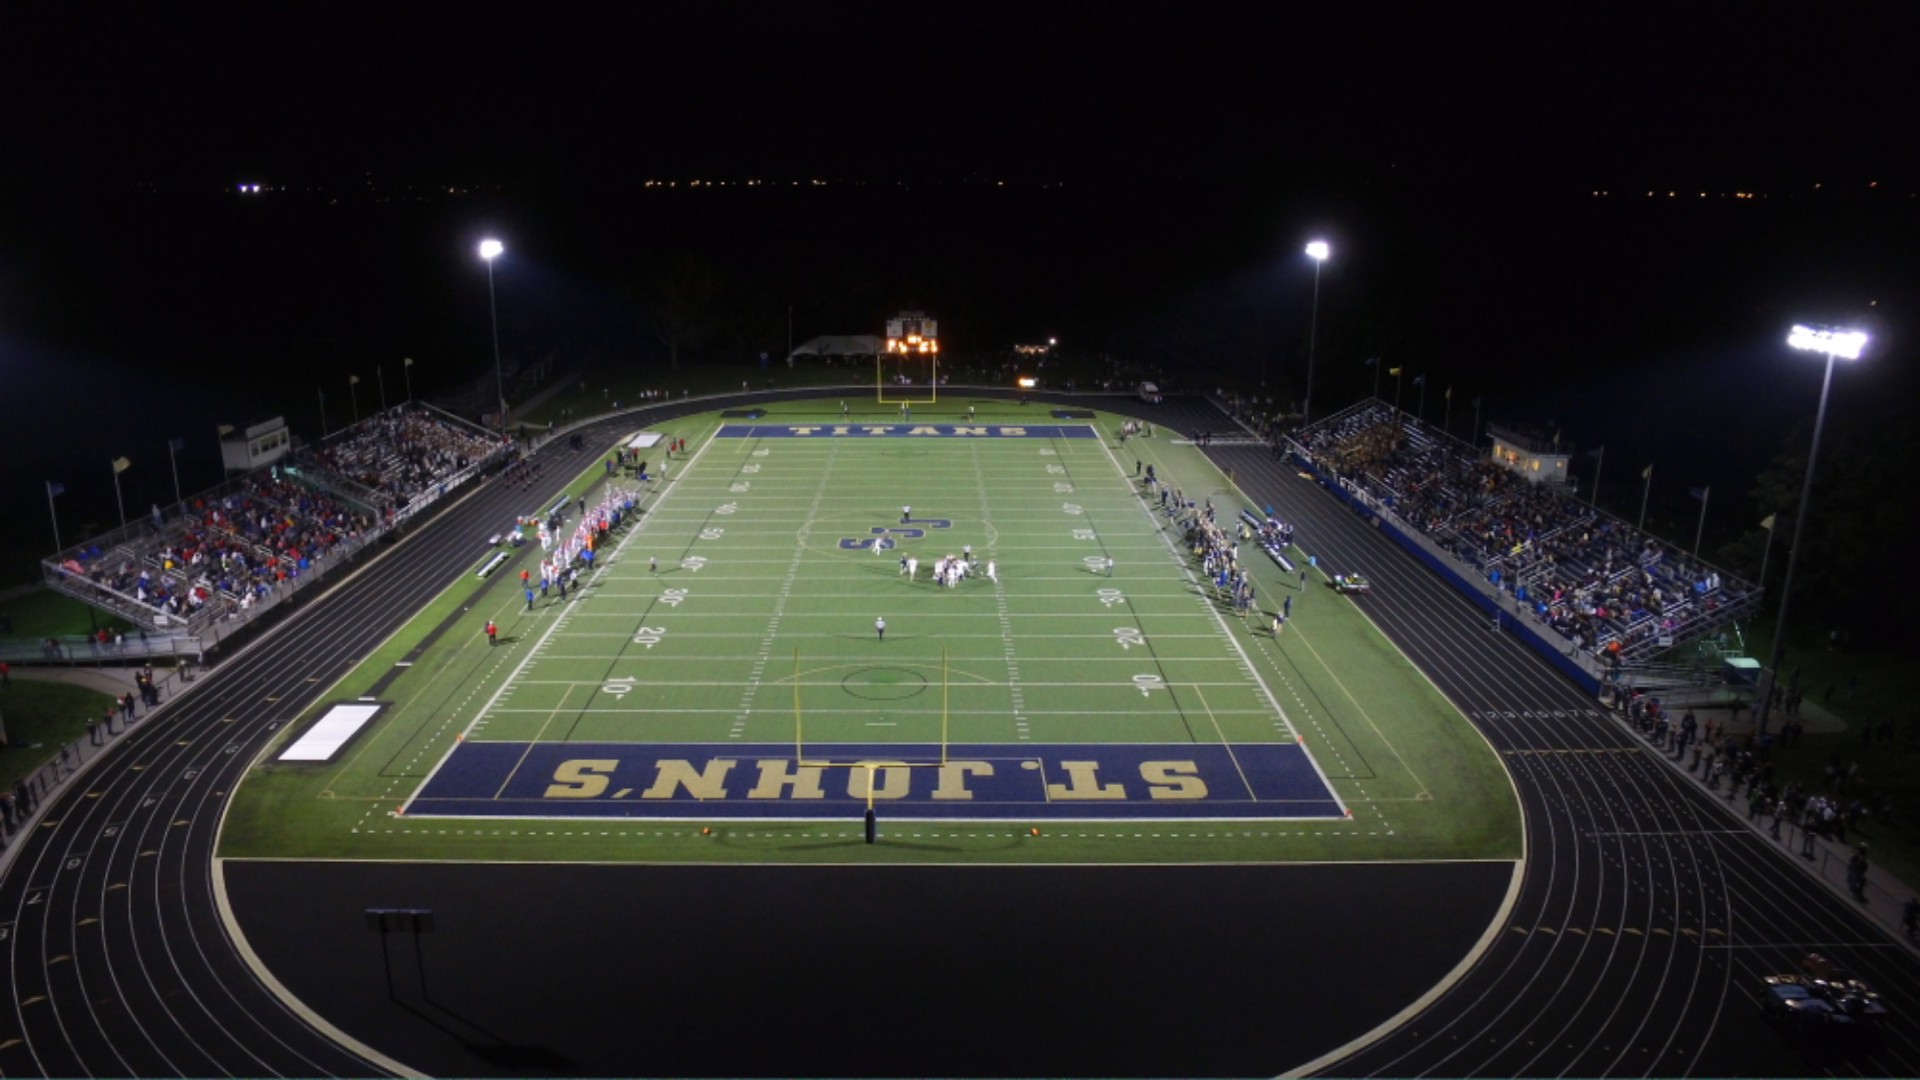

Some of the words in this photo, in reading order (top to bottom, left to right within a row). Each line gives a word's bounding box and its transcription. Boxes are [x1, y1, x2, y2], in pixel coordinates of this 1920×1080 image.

[789, 426, 1026, 436] TITANS
[659, 588, 688, 603] 30
[633, 627, 666, 644] 20
[1113, 627, 1145, 644] 20
[602, 675, 636, 693] 10
[543, 759, 995, 799] JOHN'S
[1020, 760, 1208, 800] ST.
